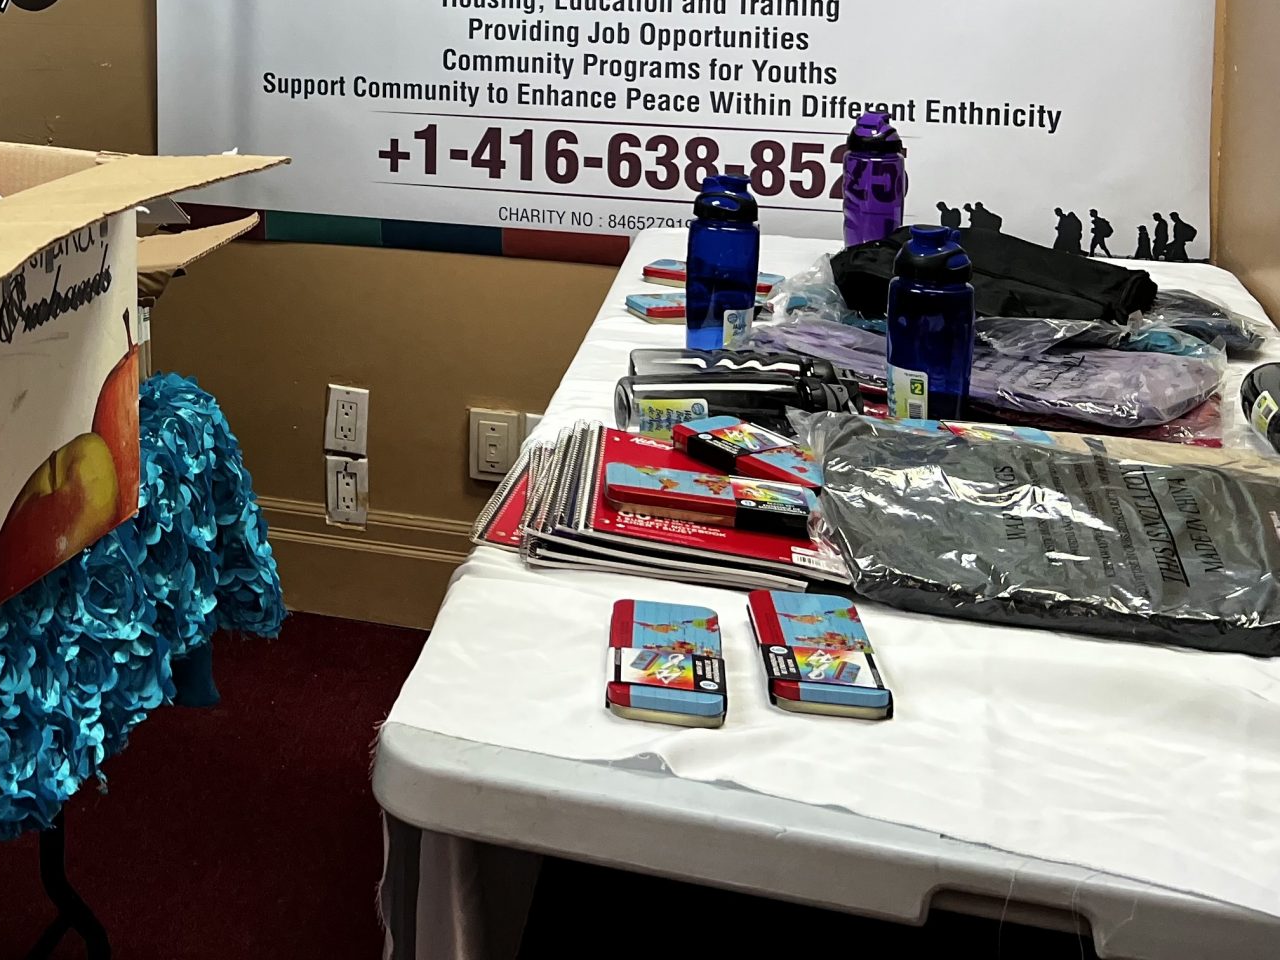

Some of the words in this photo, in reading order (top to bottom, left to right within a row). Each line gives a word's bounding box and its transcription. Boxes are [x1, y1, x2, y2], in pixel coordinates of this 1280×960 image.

[468, 18, 579, 46] Providing
[588, 20, 630, 45] Job
[639, 23, 809, 51] Opportunities
[442, 49, 574, 78] Community
[583, 53, 701, 82] Programs
[709, 58, 743, 82] for
[751, 60, 837, 85] Youths
[263, 72, 346, 99] Support
[353, 75, 480, 106] Community
[486, 80, 509, 104] to
[517, 82, 616, 109] Enhance
[625, 87, 700, 113] Peace
[709, 91, 791, 117] Within
[926, 99, 1062, 133] Enthnicity
[498, 206, 565, 225] CHARITY
[571, 210, 593, 227] NO
[1119, 464, 1151, 495] TOY
[1167, 477, 1201, 515] CHINA
[1134, 501, 1165, 528] NOT
[1185, 519, 1208, 533] IN
[1146, 530, 1174, 544] IS
[1189, 533, 1225, 574] MADE
[1152, 546, 1186, 584] THIS
